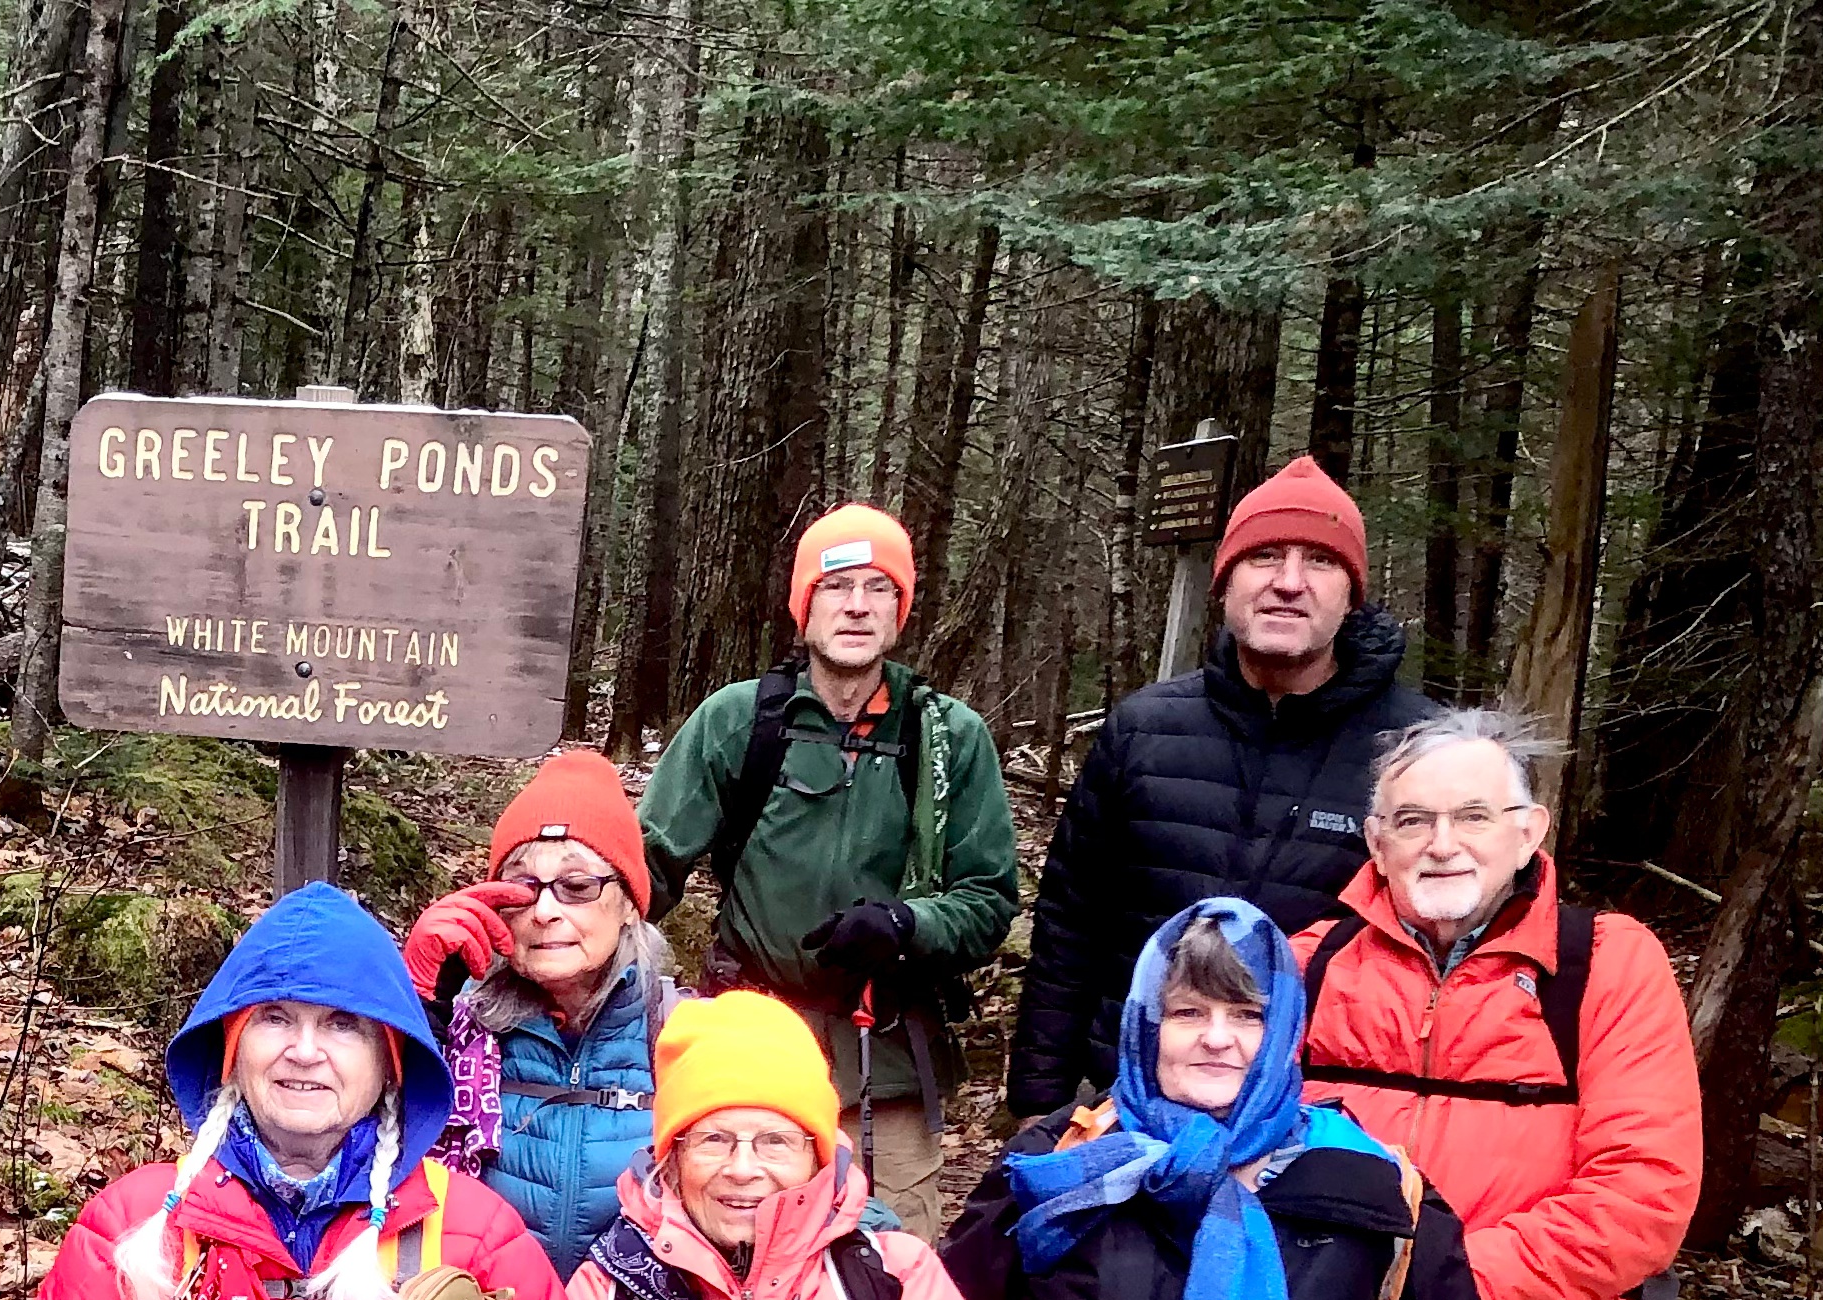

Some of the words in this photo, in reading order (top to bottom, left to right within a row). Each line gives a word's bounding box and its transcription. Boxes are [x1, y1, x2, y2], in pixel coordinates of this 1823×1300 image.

[98, 426, 335, 488] GREELEY
[379, 437, 560, 498] PONDS
[243, 500, 392, 558] TRAIL
[165, 614, 270, 655] WHITE
[285, 620, 459, 668] MOUNTAIN
[158, 674, 323, 724] National
[331, 680, 450, 730] Forest
